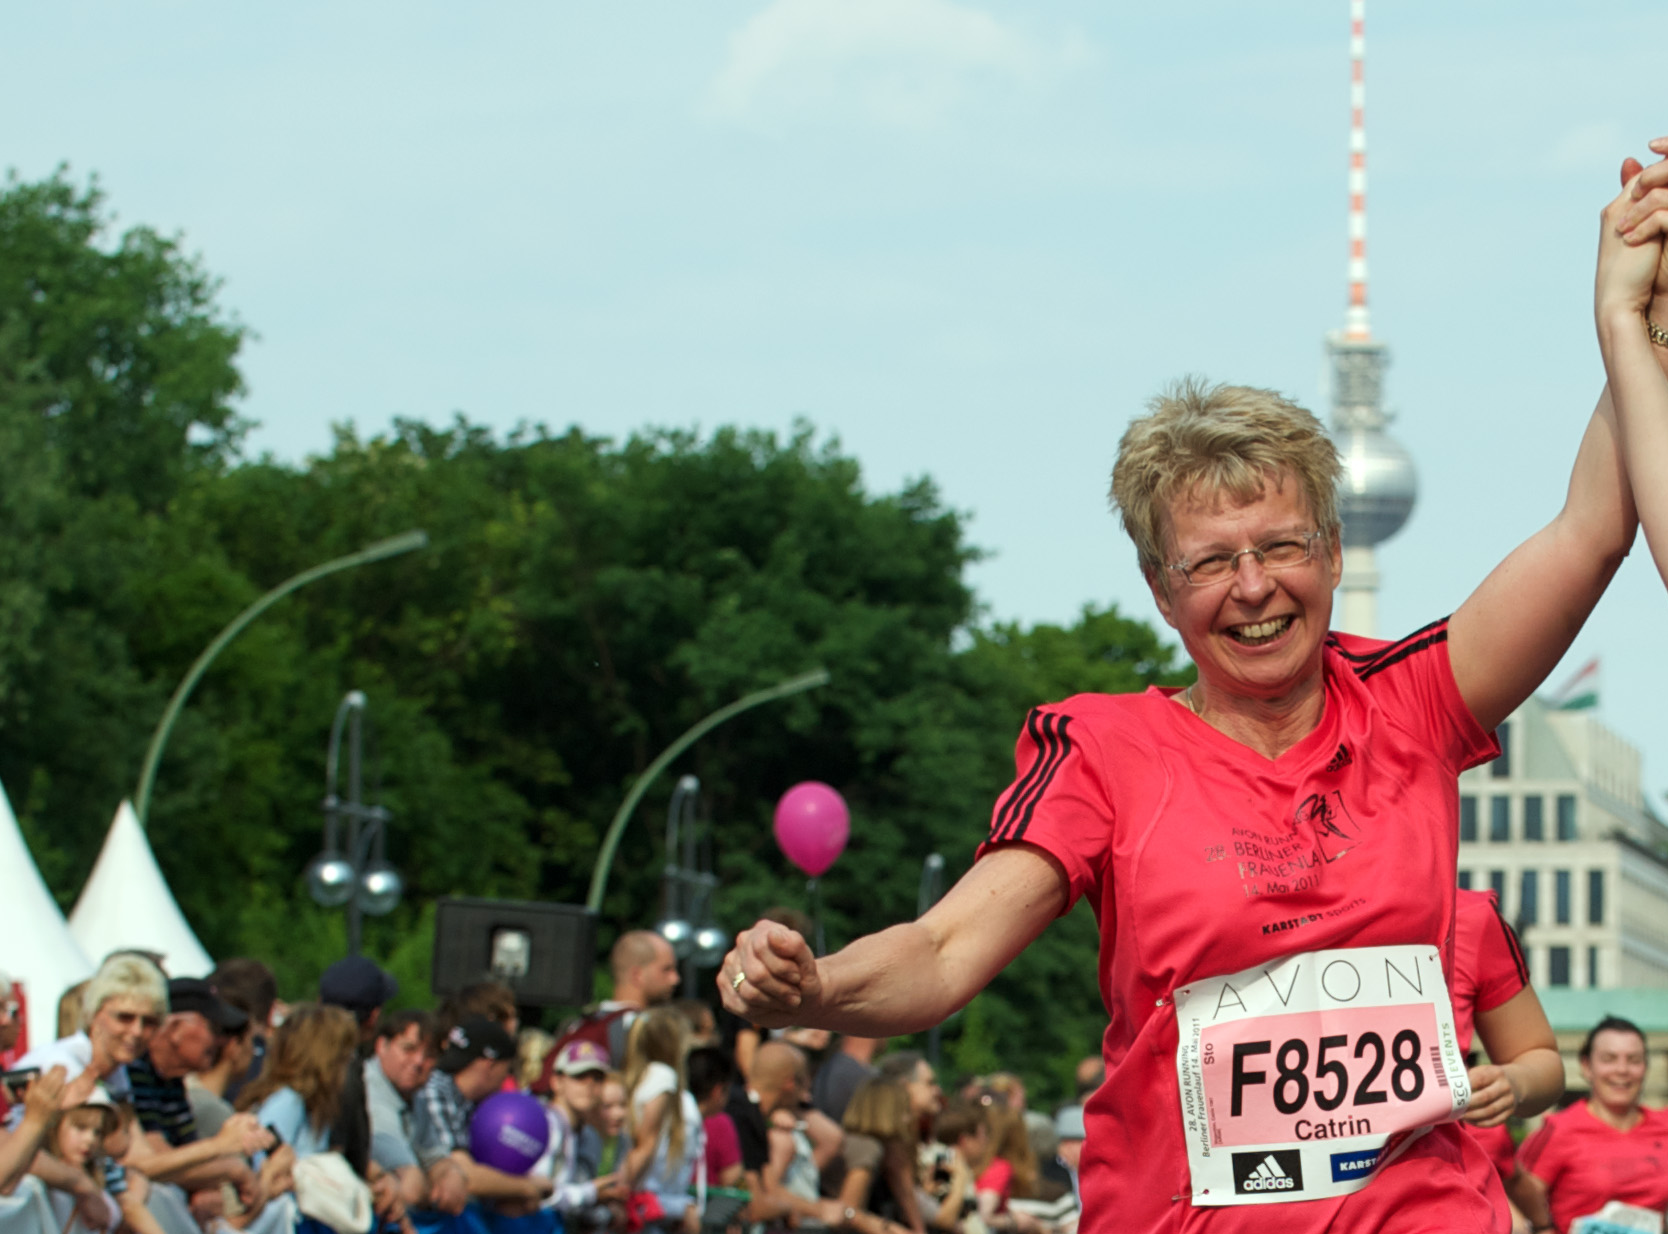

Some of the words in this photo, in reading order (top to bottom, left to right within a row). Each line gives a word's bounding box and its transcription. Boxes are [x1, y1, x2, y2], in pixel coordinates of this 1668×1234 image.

[1234, 841, 1304, 862] BERLINER
[1238, 850, 1322, 880] FRAUENLA
[1267, 881, 1290, 895] Mai
[1292, 875, 1319, 892] 2011
[1262, 913, 1324, 936] KARSTADT
[1326, 898, 1366, 917] sports
[1212, 956, 1423, 1020] AVON
[1191, 1018, 1201, 1037] 2011
[1203, 1043, 1215, 1065] Sto
[1442, 1022, 1459, 1072] EVENTS
[1181, 1045, 1193, 1087] RUNNING
[1230, 1028, 1425, 1118] F8528
[1184, 1089, 1196, 1116] AVON
[1193, 1072, 1207, 1120] Frauenlauf
[1200, 1121, 1211, 1158] Berliner
[1295, 1115, 1371, 1141] Catrin
[1339, 1157, 1377, 1172] KARST
[1243, 1176, 1294, 1191] adidas
